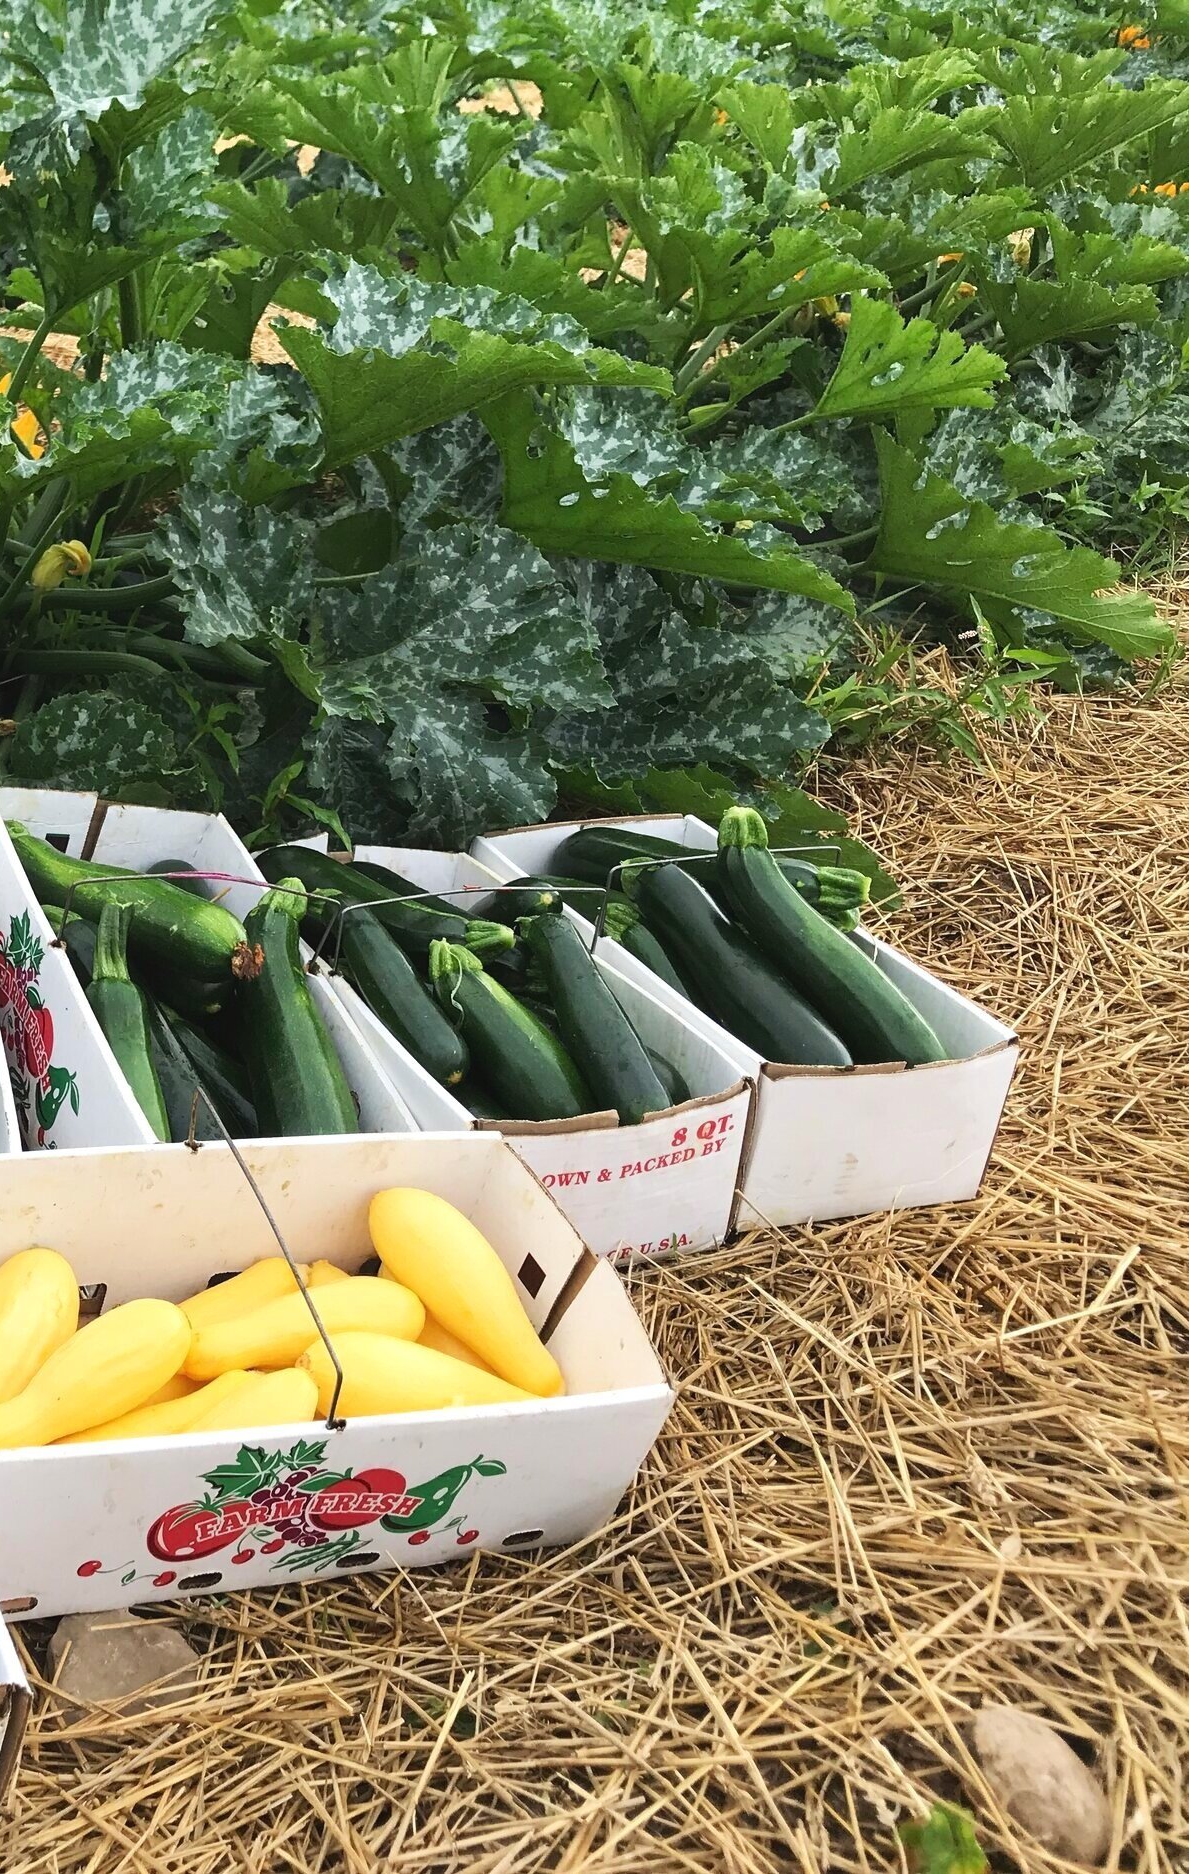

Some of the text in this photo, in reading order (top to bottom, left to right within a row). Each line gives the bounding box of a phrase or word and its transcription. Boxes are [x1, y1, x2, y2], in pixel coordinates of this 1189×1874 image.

[671, 1114, 735, 1147] 8 QT.
[541, 1138, 726, 1188] OWN & PACKED BY
[196, 1492, 425, 1543] FARM FRESH
